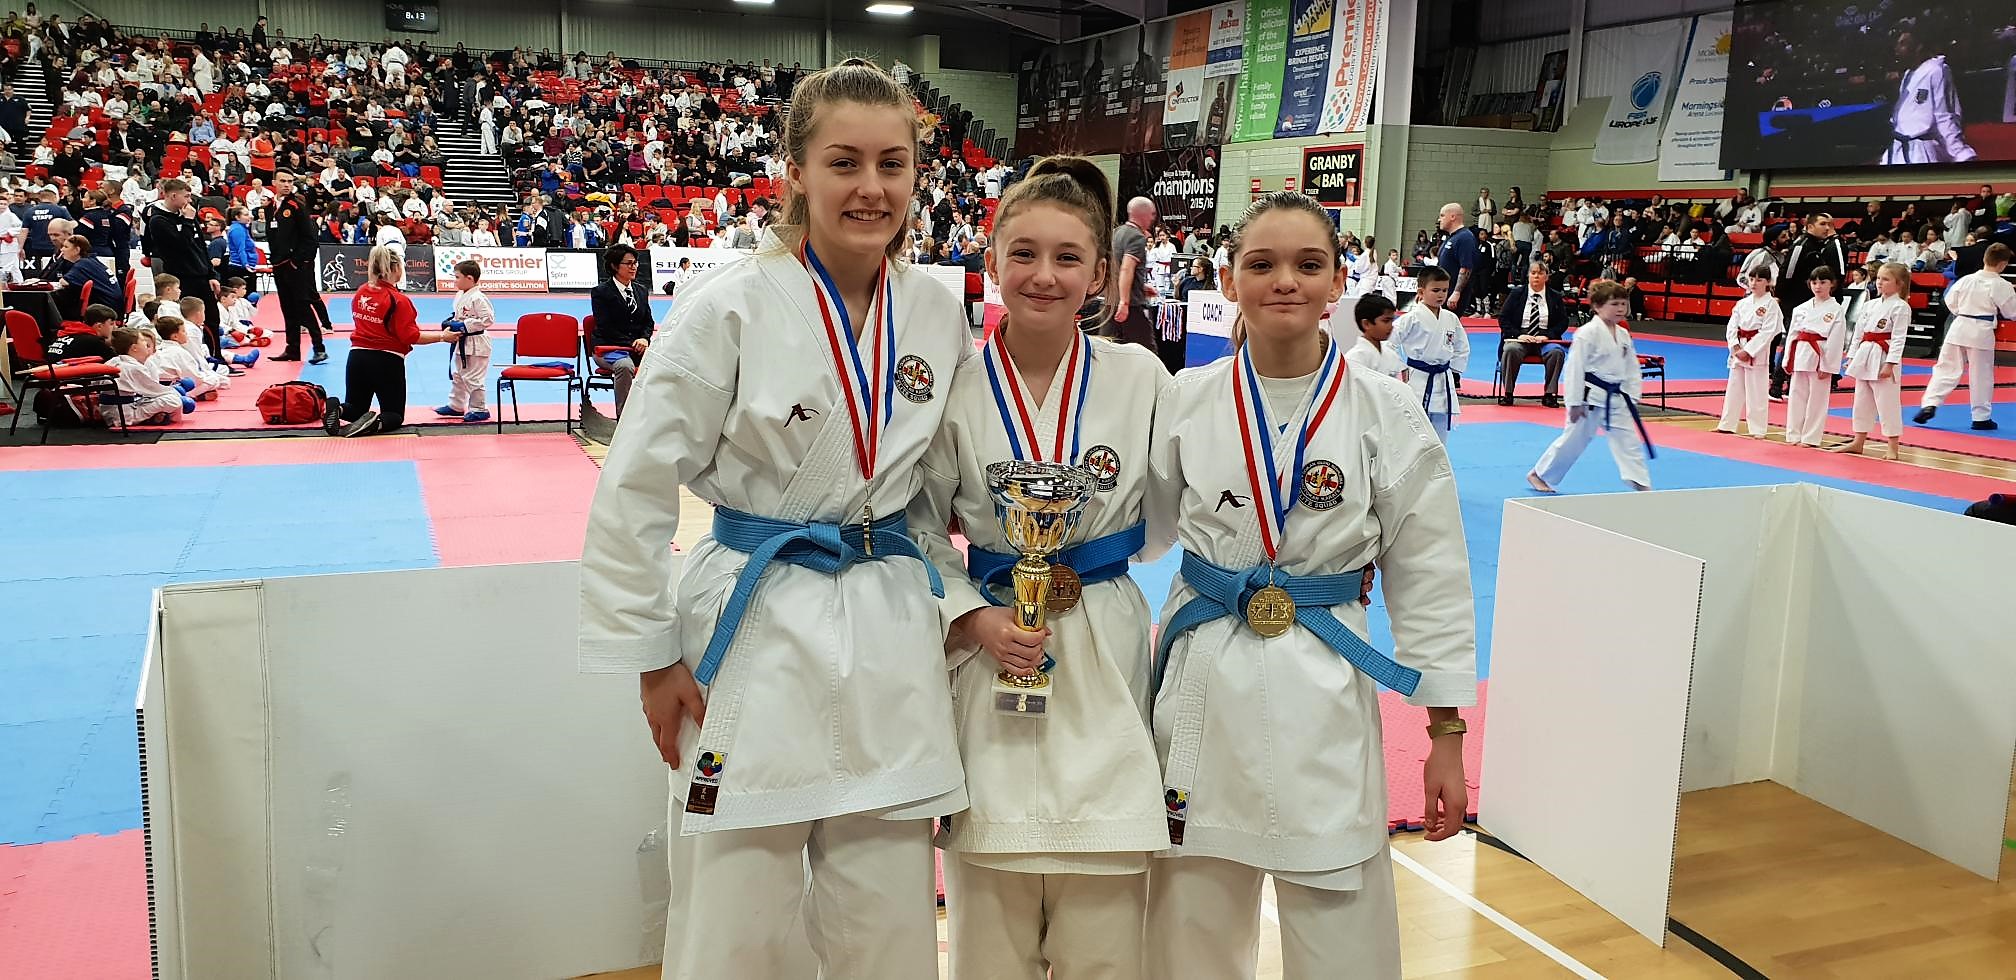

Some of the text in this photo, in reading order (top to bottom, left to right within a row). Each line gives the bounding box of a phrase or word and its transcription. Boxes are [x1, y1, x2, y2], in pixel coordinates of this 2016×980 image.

[1334, 0, 1356, 87] Premie
[1360, 29, 1372, 75] LOGISTIC
[1309, 154, 1356, 171] GRANBY
[1153, 173, 1215, 200] champions
[1321, 172, 1344, 188] BAR
[406, 259, 430, 268] Clinic
[470, 253, 543, 269] Premier
[1202, 303, 1223, 322] COACH
